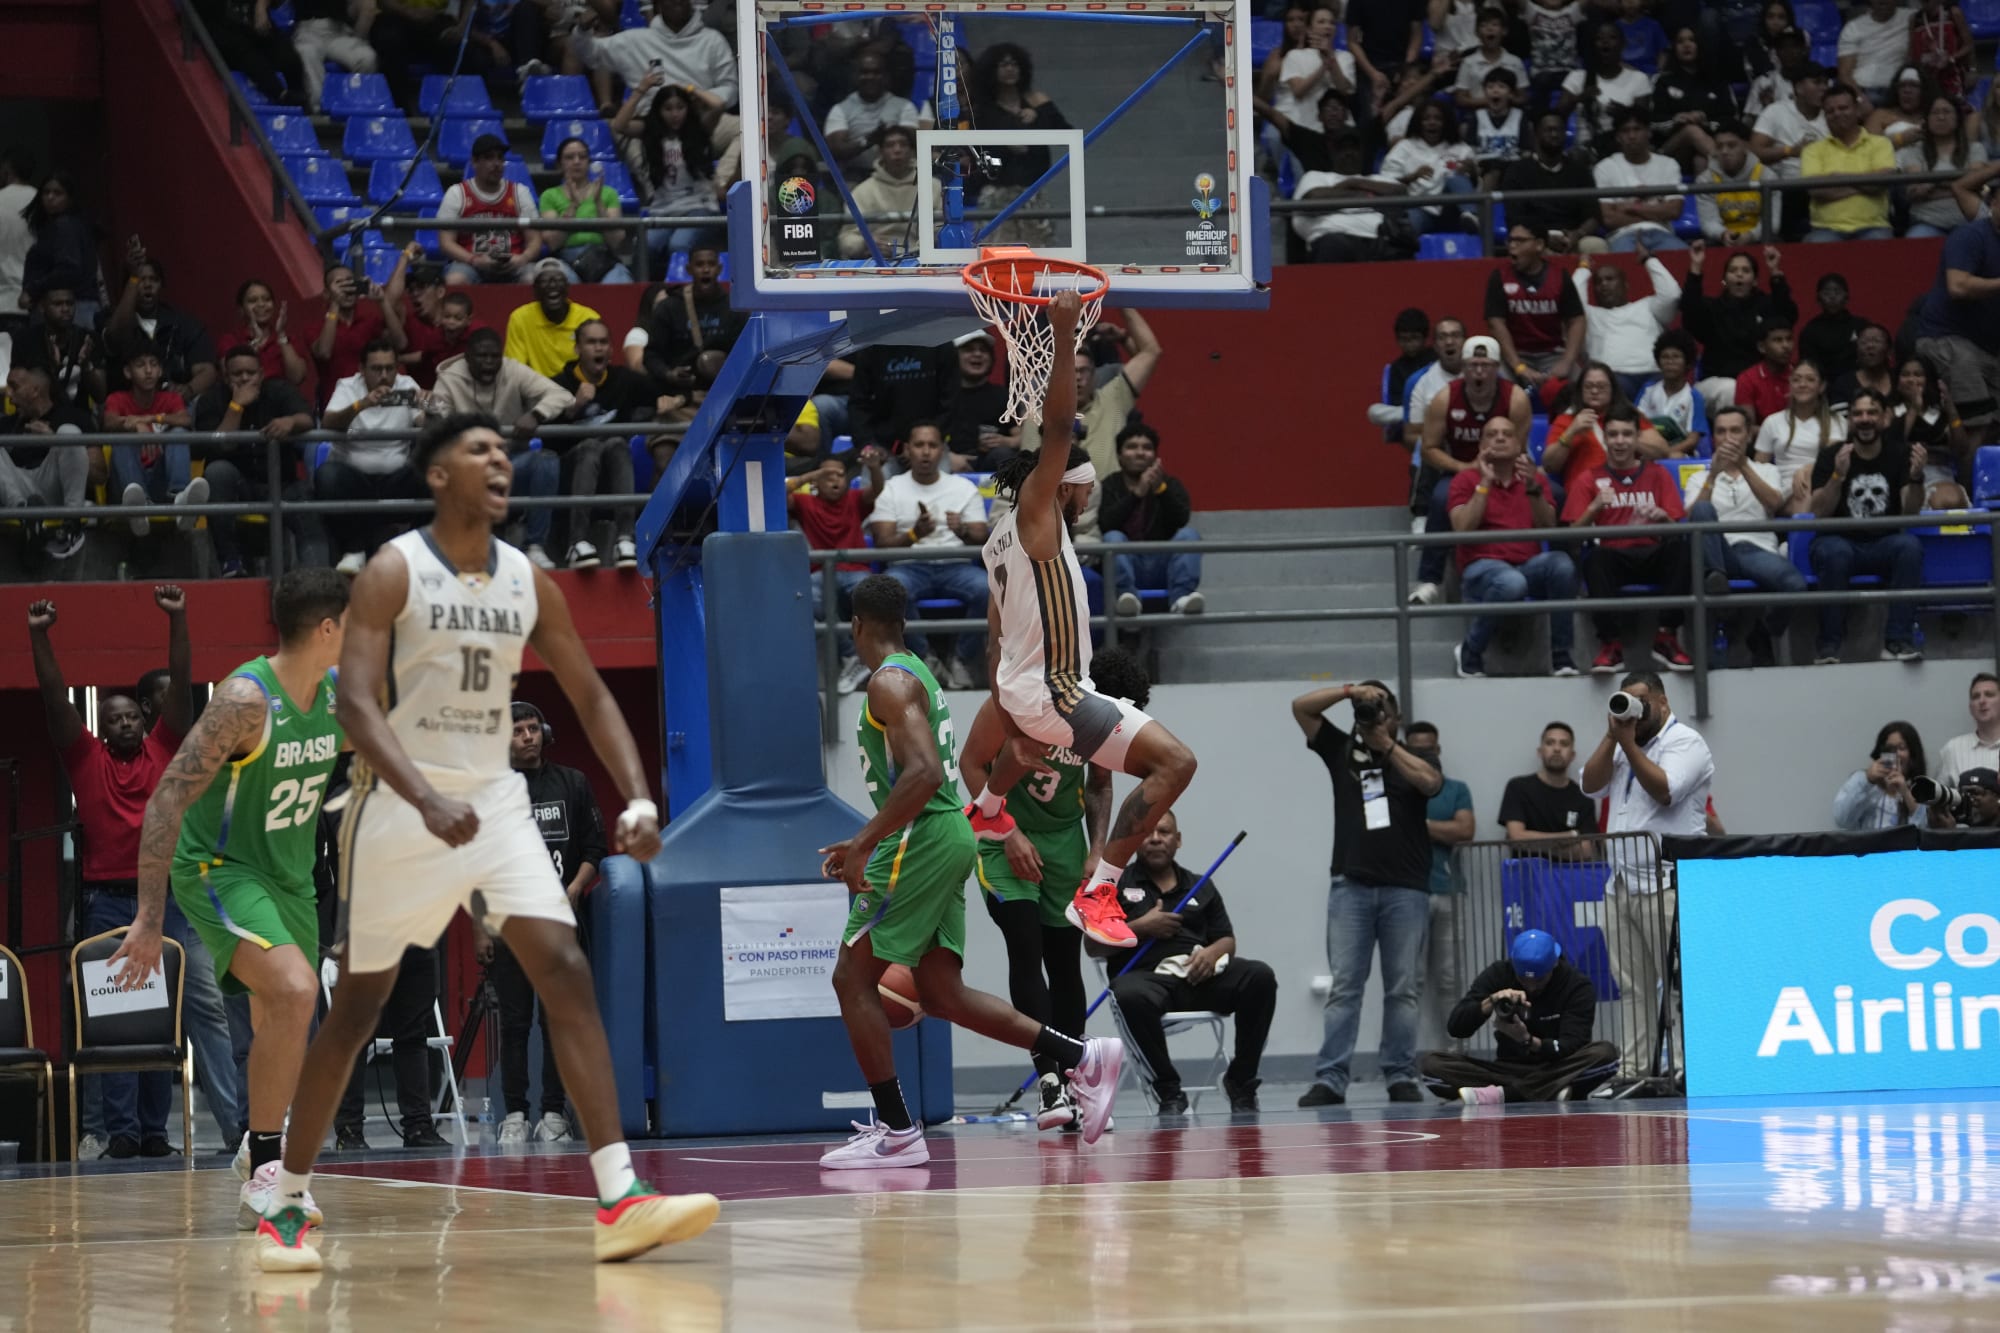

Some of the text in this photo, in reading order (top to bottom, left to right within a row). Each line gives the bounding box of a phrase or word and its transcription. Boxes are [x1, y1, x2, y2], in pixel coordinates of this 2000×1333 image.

[941, 20, 957, 96] MONDO
[784, 224, 813, 239] FIBA
[1186, 230, 1227, 241] AMERICUP
[1186, 246, 1228, 256] QUALIFIERS
[1509, 299, 1558, 315] PANAMA
[1605, 491, 1655, 508] ANAMA
[430, 604, 522, 636] PANAMA
[460, 645, 491, 692] 16
[440, 706, 484, 719] Copa
[274, 734, 337, 768] BRASIL
[1027, 771, 1061, 803] 3
[265, 773, 328, 832] 25
[534, 806, 560, 821] FIBA
[1869, 898, 2000, 971] Co
[739, 948, 836, 962] CON PASO FIRME
[750, 966, 826, 977] PANDEPORTES
[91, 980, 156, 997] COURSDE
